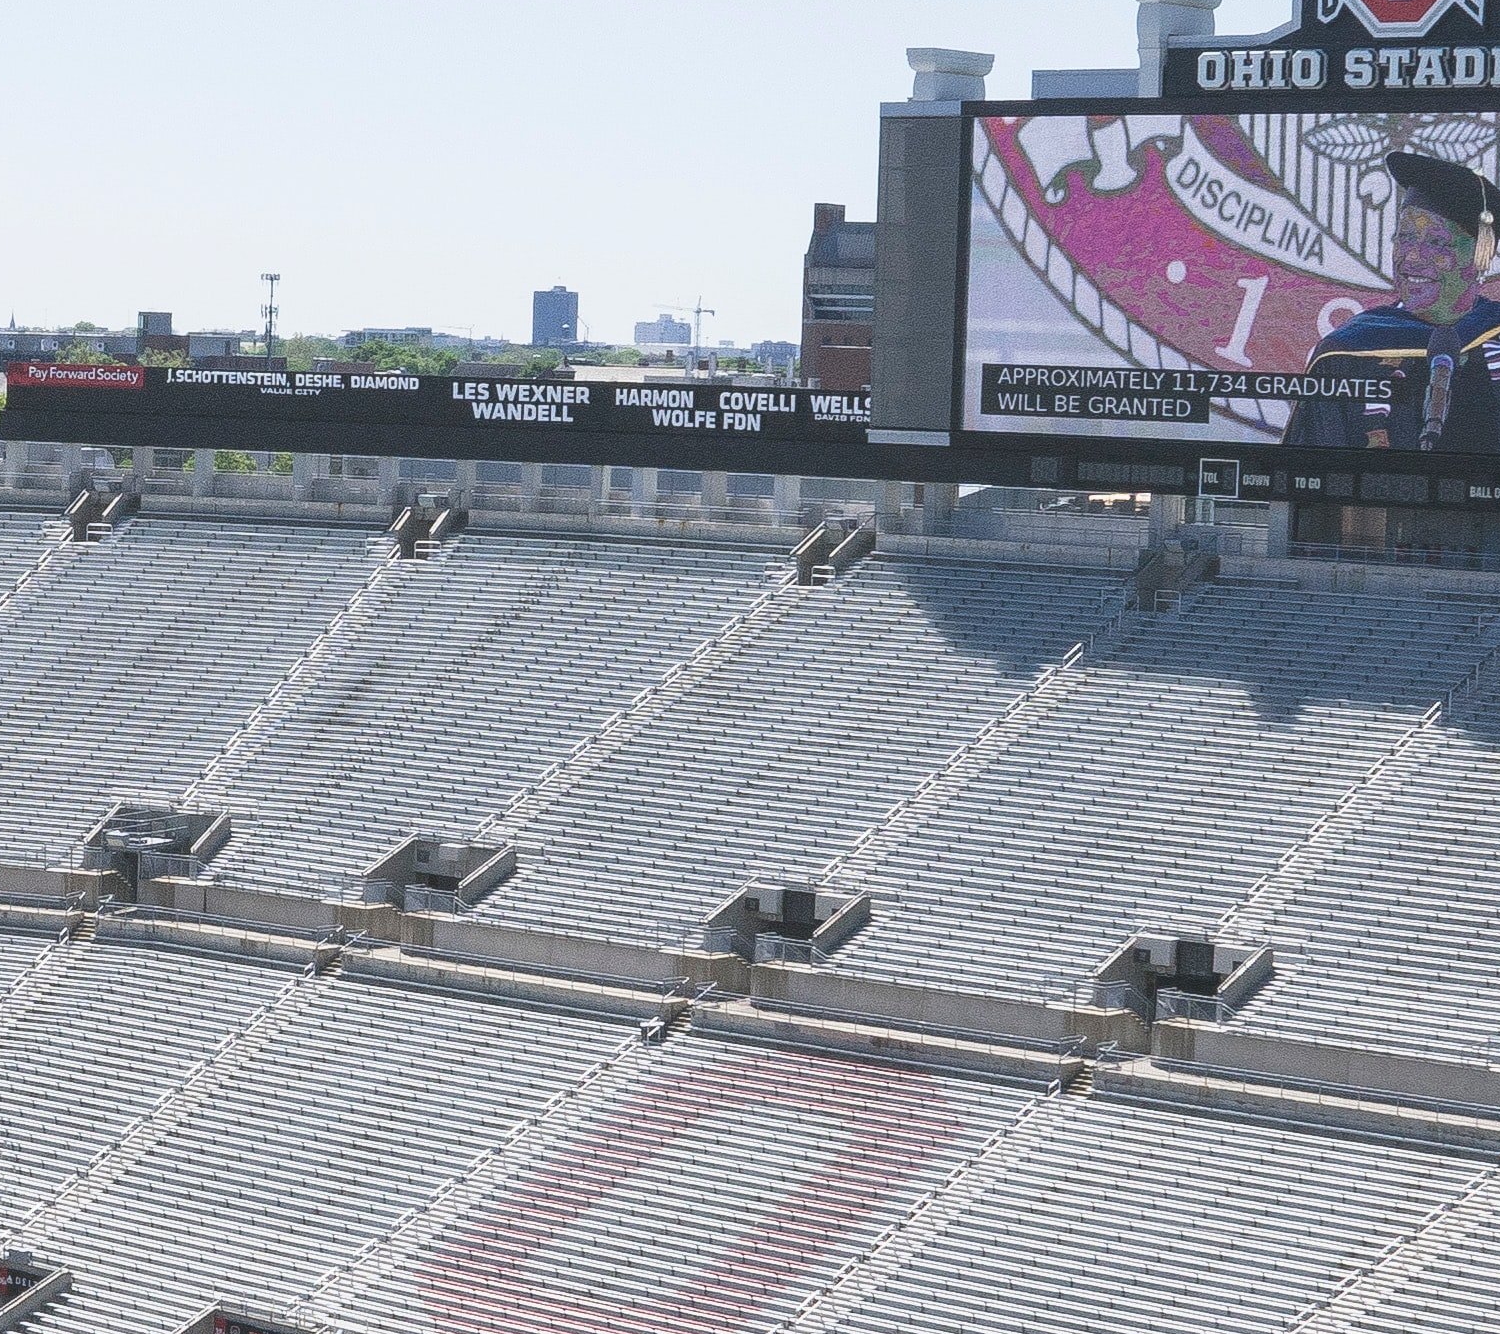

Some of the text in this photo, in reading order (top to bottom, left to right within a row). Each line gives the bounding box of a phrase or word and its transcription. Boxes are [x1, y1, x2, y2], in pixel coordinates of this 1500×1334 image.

[1197, 49, 1328, 90] OHIO
[1173, 158, 1325, 267] DISCIPLINA
[28, 365, 139, 385] Pay Forward Society
[295, 373, 346, 390] DESHE,
[350, 375, 420, 390] DIAMOND
[997, 367, 1392, 398] APPROXIMATELY 11,734 GRADUATES
[260, 387, 321, 396] VALUE CITY
[452, 381, 590, 404] LES WEXNER
[615, 387, 694, 409] HARMON
[719, 391, 796, 413] COVELLI
[471, 402, 574, 423] WANDELL
[997, 392, 1191, 417] WILL BE GRANTED
[651, 408, 761, 432] WOLFE FDN
[814, 413, 847, 423] DAVIS
[1469, 485, 1493, 499] BALL
